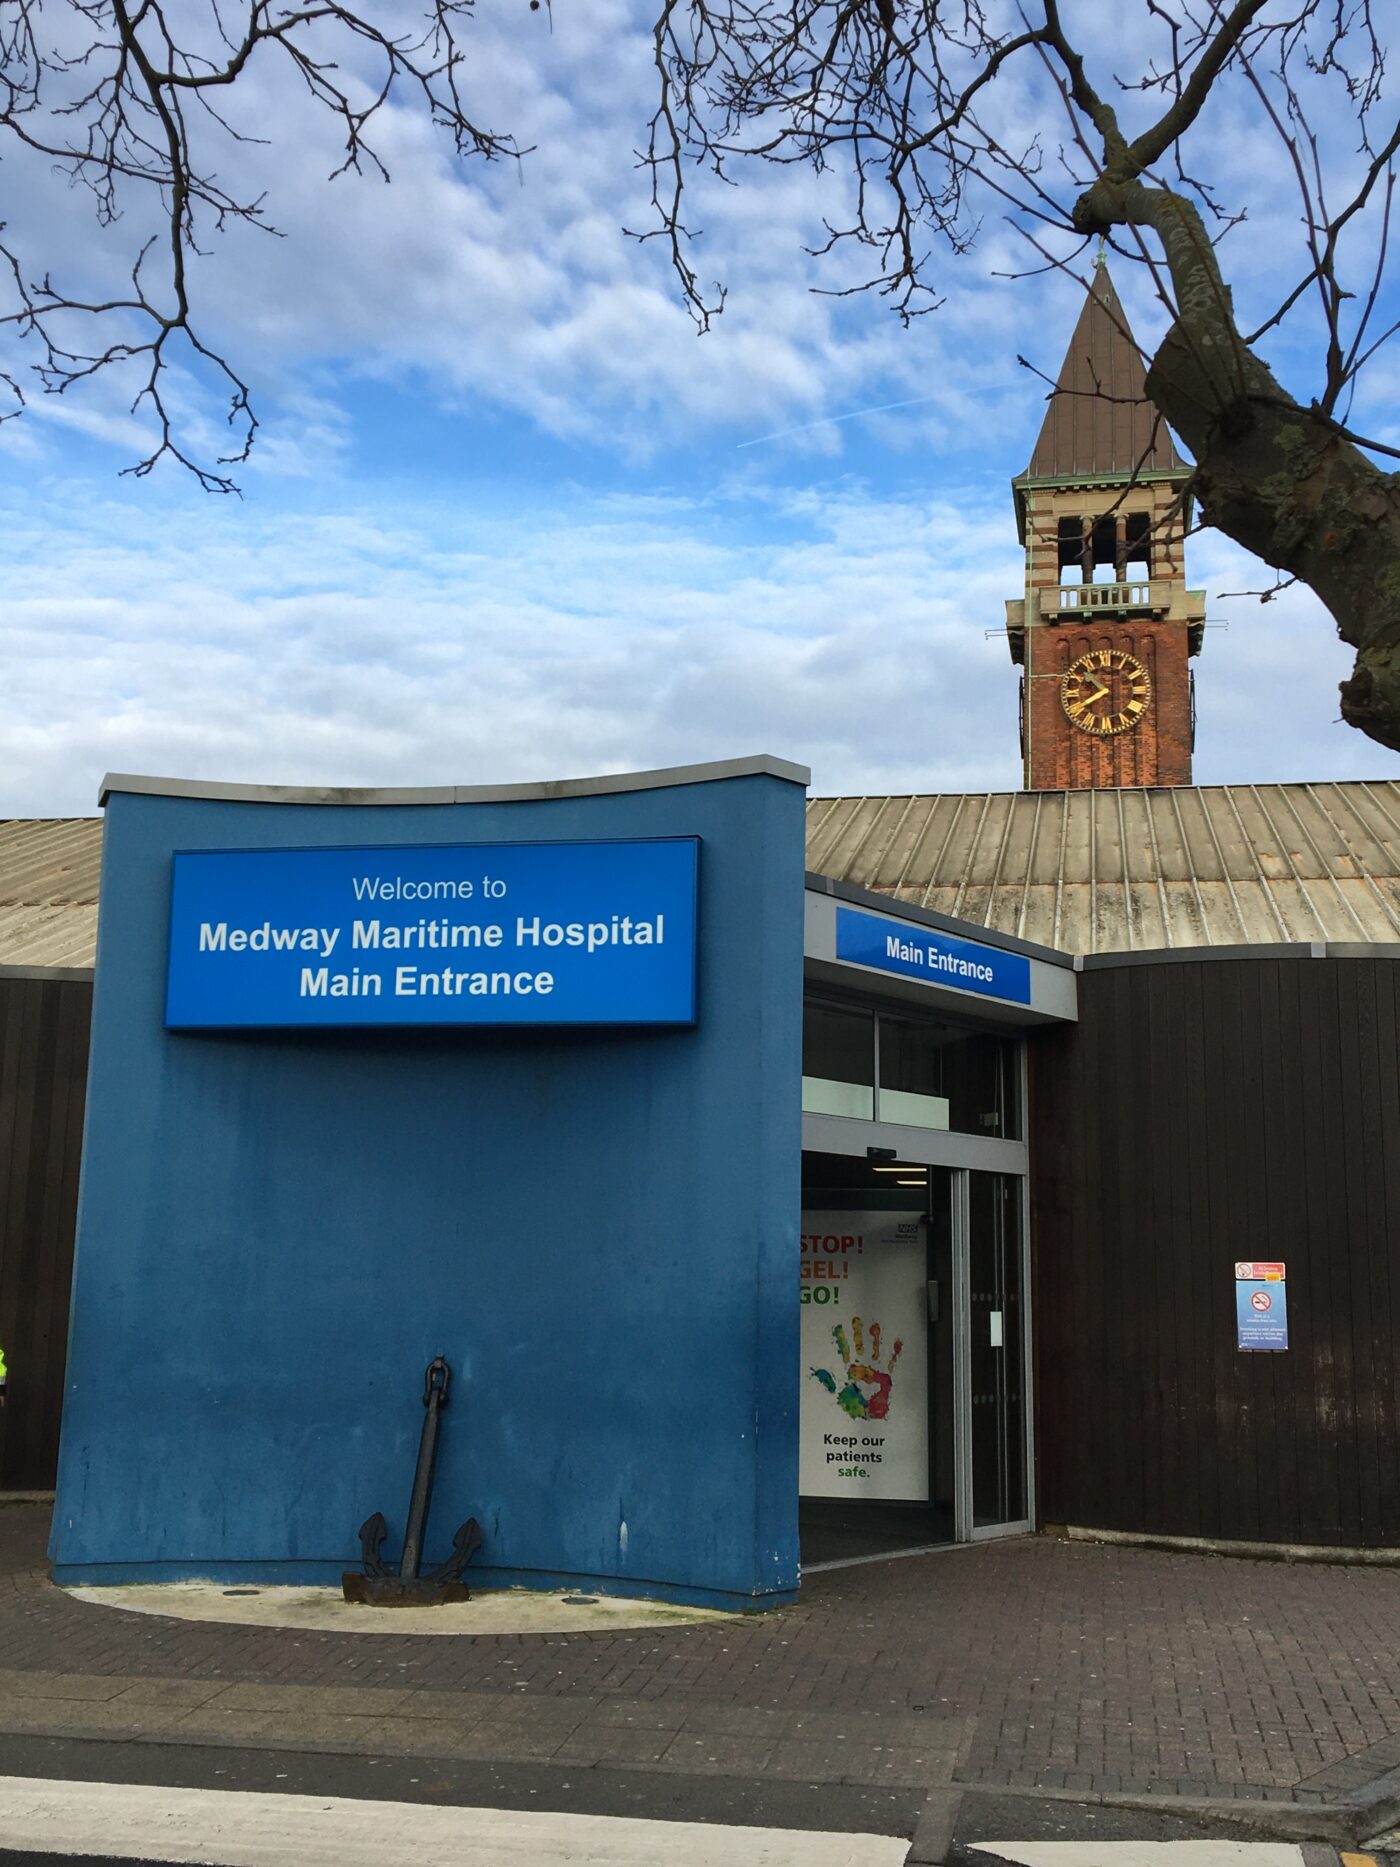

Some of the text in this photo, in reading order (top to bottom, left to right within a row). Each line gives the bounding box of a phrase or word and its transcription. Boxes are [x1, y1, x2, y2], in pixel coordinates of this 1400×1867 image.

[353, 876, 506, 900] Welcome to
[199, 914, 664, 958] Medway Maritime Hospital
[887, 936, 993, 982] Main Entrance
[300, 966, 554, 997] Main Entrance
[800, 1234, 863, 1255] STOP!
[800, 1260, 849, 1279] GEL!
[800, 1285, 840, 1305] GO!
[824, 1433, 886, 1448] Keep our
[826, 1450, 883, 1464] patients
[837, 1465, 871, 1478] safe.
